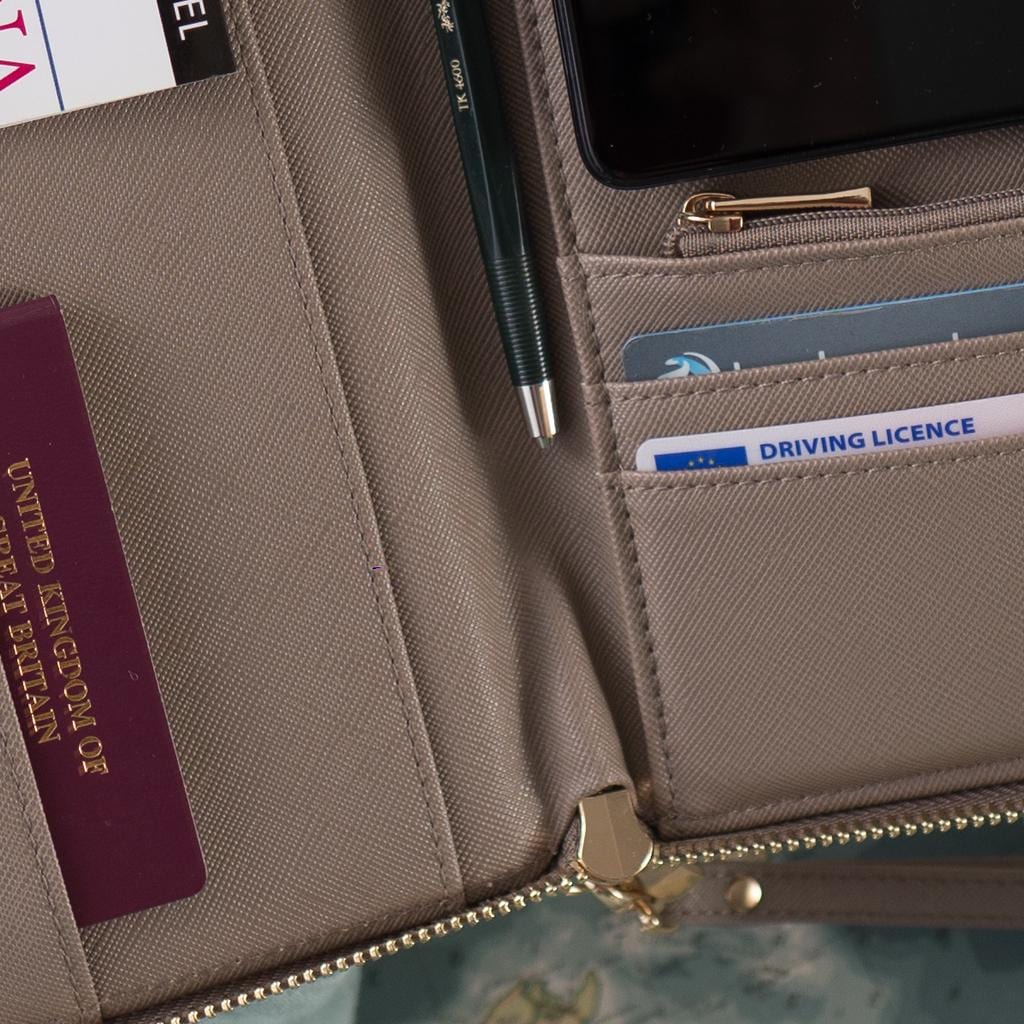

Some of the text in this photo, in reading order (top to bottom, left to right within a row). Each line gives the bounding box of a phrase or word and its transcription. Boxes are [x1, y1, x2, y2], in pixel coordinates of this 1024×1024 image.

[760, 417, 976, 460] DRIVING LICENCE
[0, 515, 62, 745] REAT BRITAIN
[7, 458, 110, 775] UNITED KINGDOM OF
